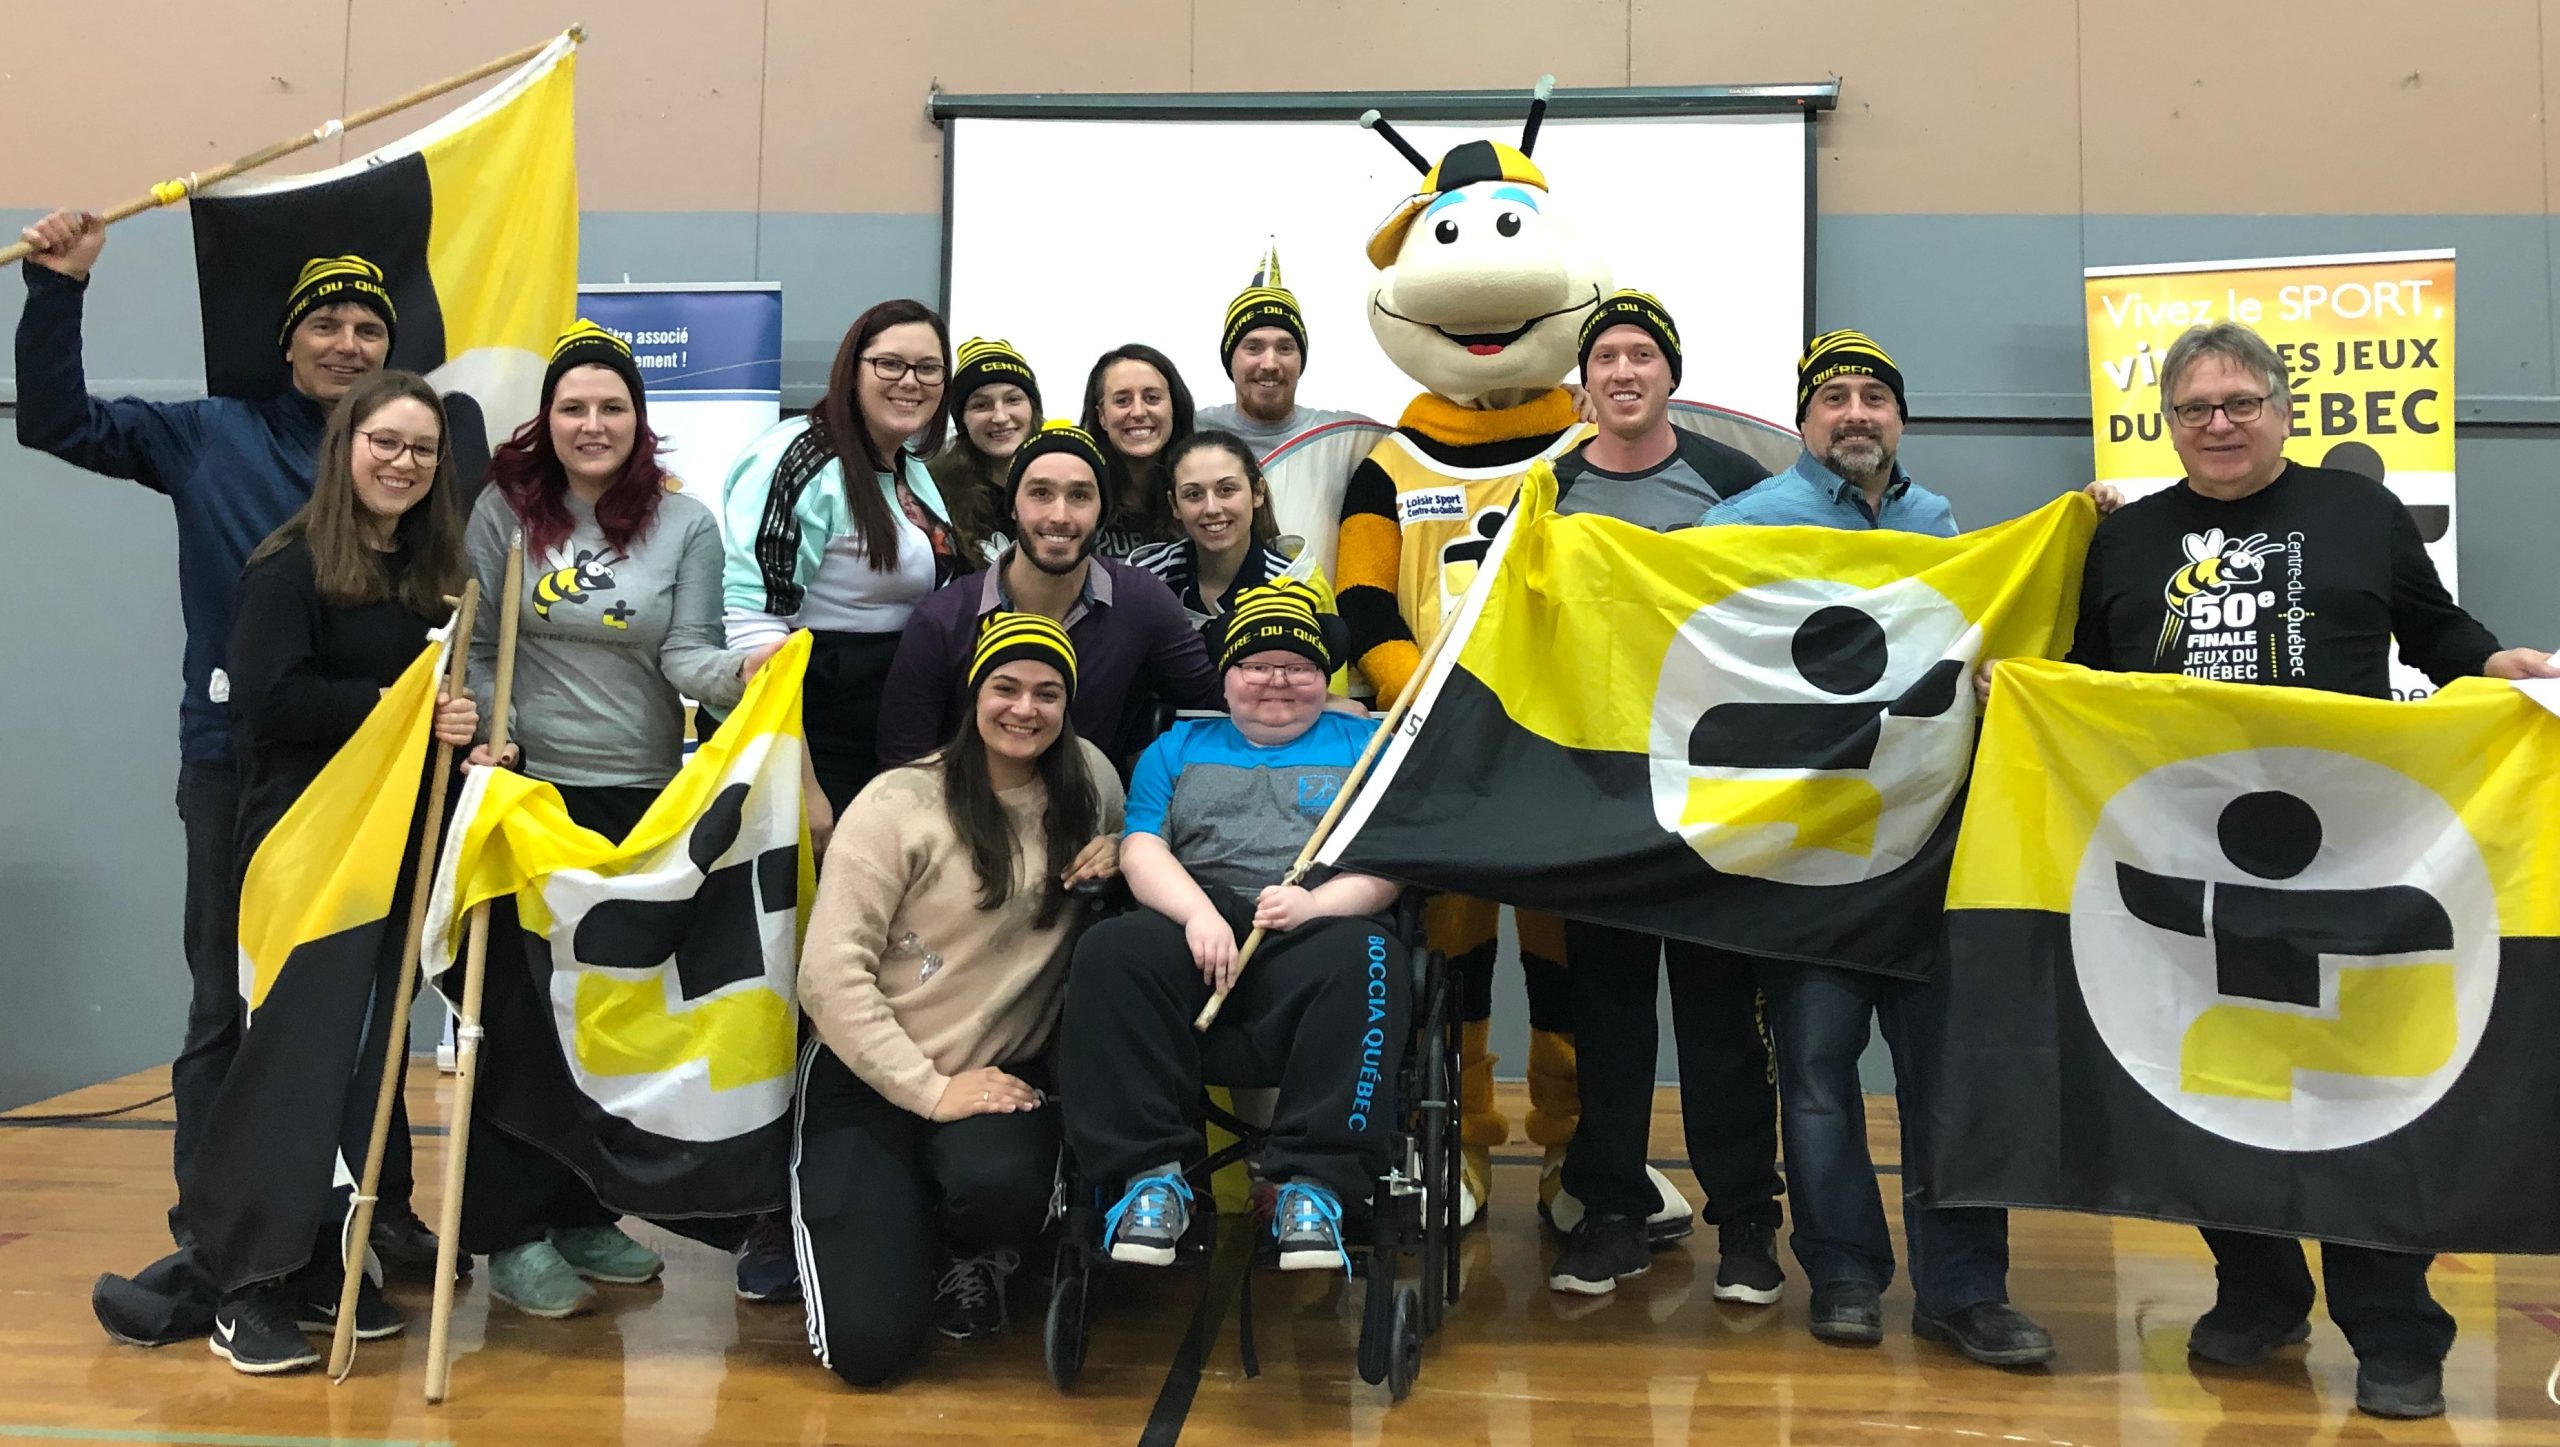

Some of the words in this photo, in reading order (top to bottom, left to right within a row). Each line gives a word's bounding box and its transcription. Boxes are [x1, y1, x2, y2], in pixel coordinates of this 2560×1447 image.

[2101, 289, 2213, 328] Vivez
[2227, 289, 2263, 323] le
[2279, 280, 2444, 322] SPORT,
[636, 327, 689, 345] associé
[634, 352, 678, 368] ement
[2276, 343, 2321, 374] ES
[2333, 338, 2440, 376] JEUX
[2110, 413, 2162, 443] DU
[2289, 377, 2441, 437] ÉBEC
[1406, 495, 1433, 508] Loisir
[1435, 494, 1461, 505] Sport
[2287, 531, 2306, 678] Centre-du-Québec
[2183, 652, 2229, 666] JEUX
[2232, 649, 2258, 663] DU
[2186, 631, 2258, 649] FINALE
[1367, 935, 1387, 1023] BOCCIA
[1348, 1028, 1383, 1133] QUÉBEC
